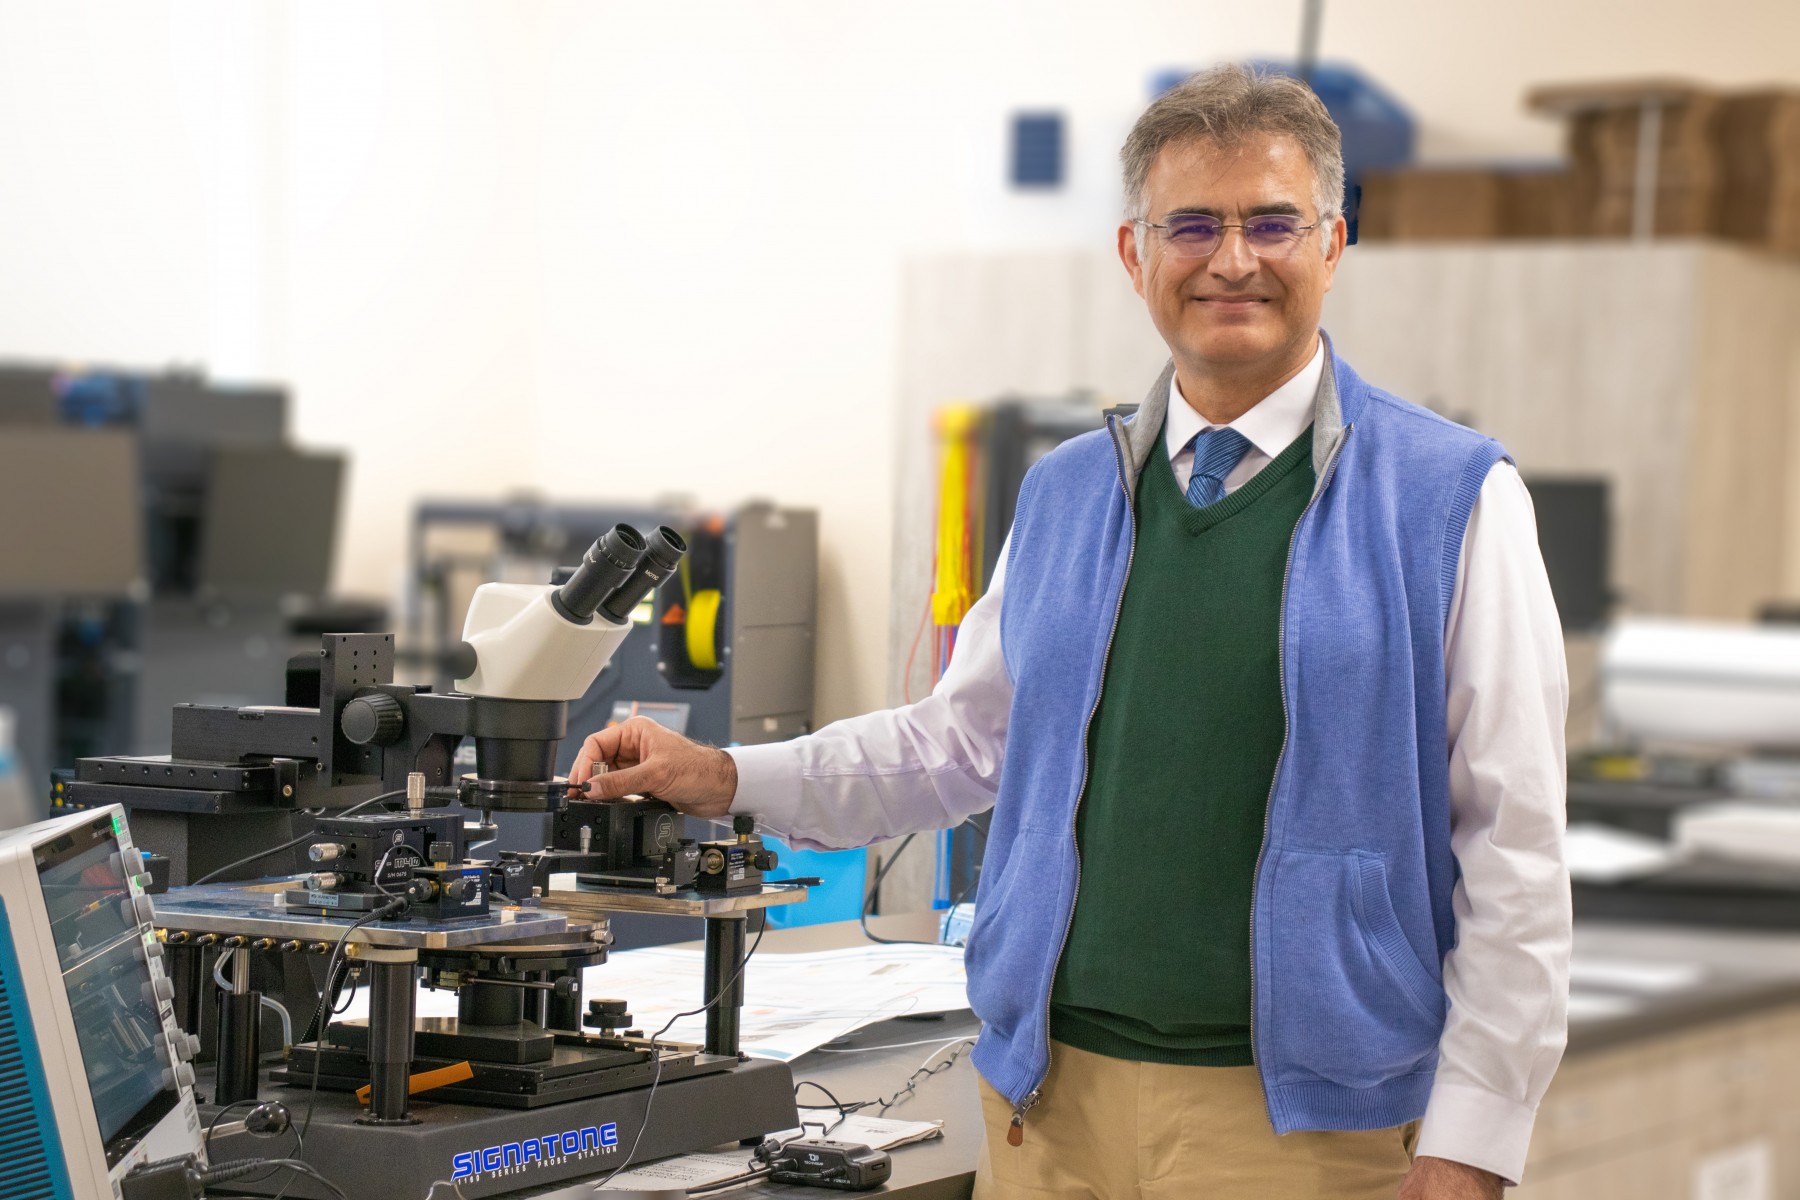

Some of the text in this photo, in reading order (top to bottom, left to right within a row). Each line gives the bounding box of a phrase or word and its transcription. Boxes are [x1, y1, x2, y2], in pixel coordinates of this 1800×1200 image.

[450, 1122, 618, 1181] SIGNATONE
[457, 1146, 617, 1186] 1160 SERIES PROBE STATION
